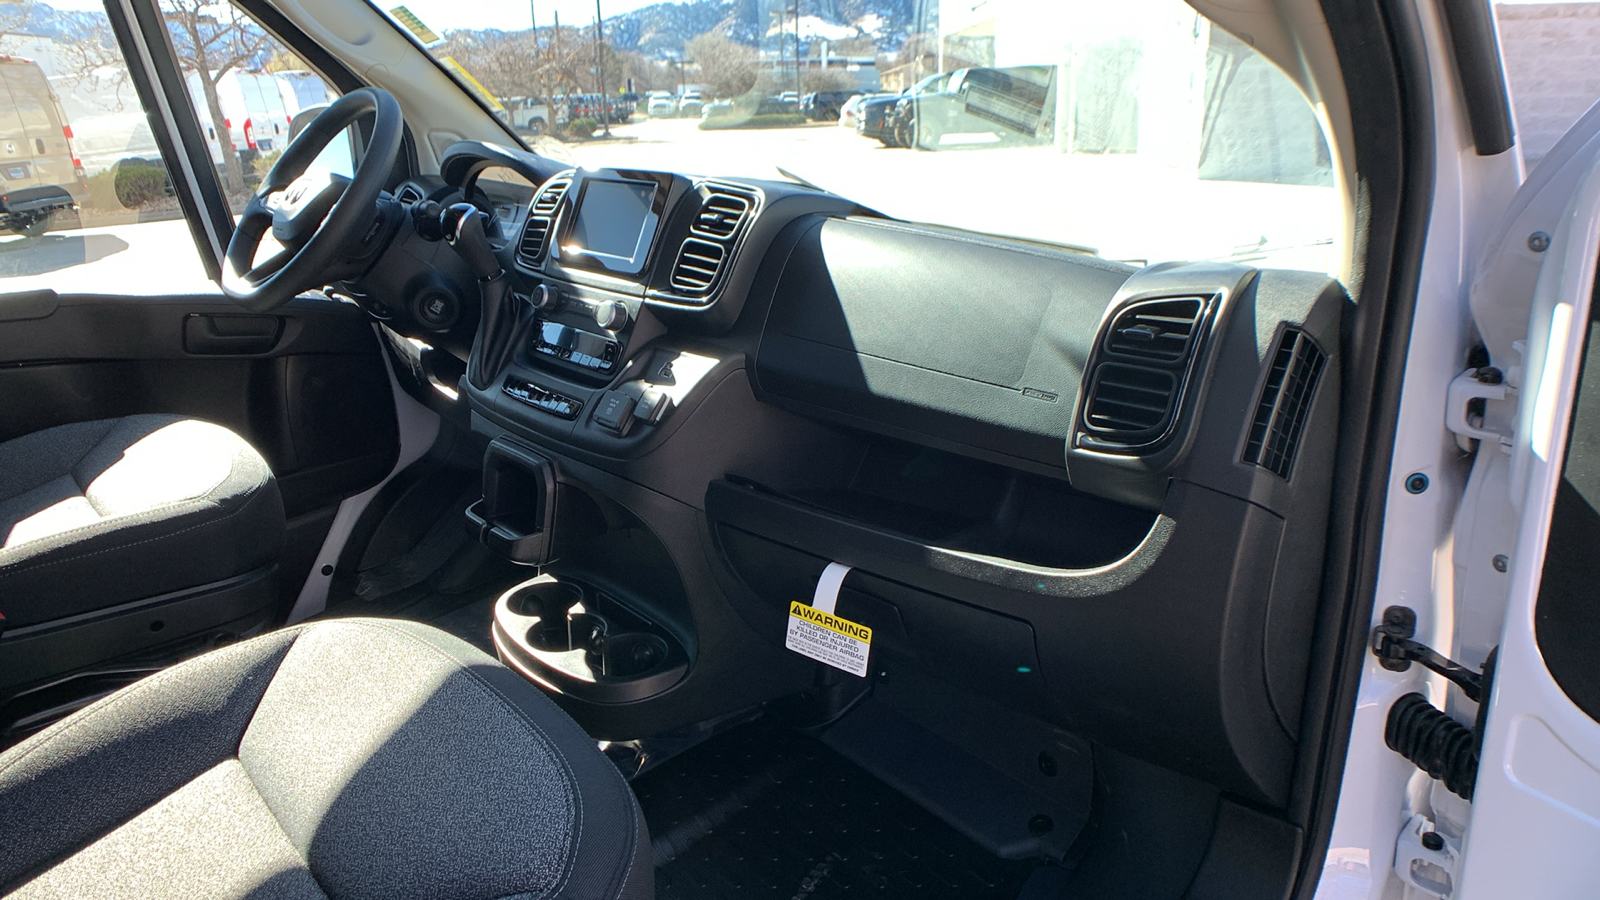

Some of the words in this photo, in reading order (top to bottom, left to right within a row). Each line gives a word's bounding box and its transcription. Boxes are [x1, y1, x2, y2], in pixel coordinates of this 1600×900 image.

[796, 625, 817, 637] KILLED
[818, 633, 828, 641] OR
[829, 637, 858, 653] INJURED
[798, 619, 830, 635] CHILDREN
[832, 632, 846, 641] CAN
[848, 638, 857, 646] BE
[802, 608, 868, 640] WARNING
[789, 628, 798, 636] BY
[799, 632, 837, 651] PASSENGER
[838, 647, 864, 661] AIRBAG
